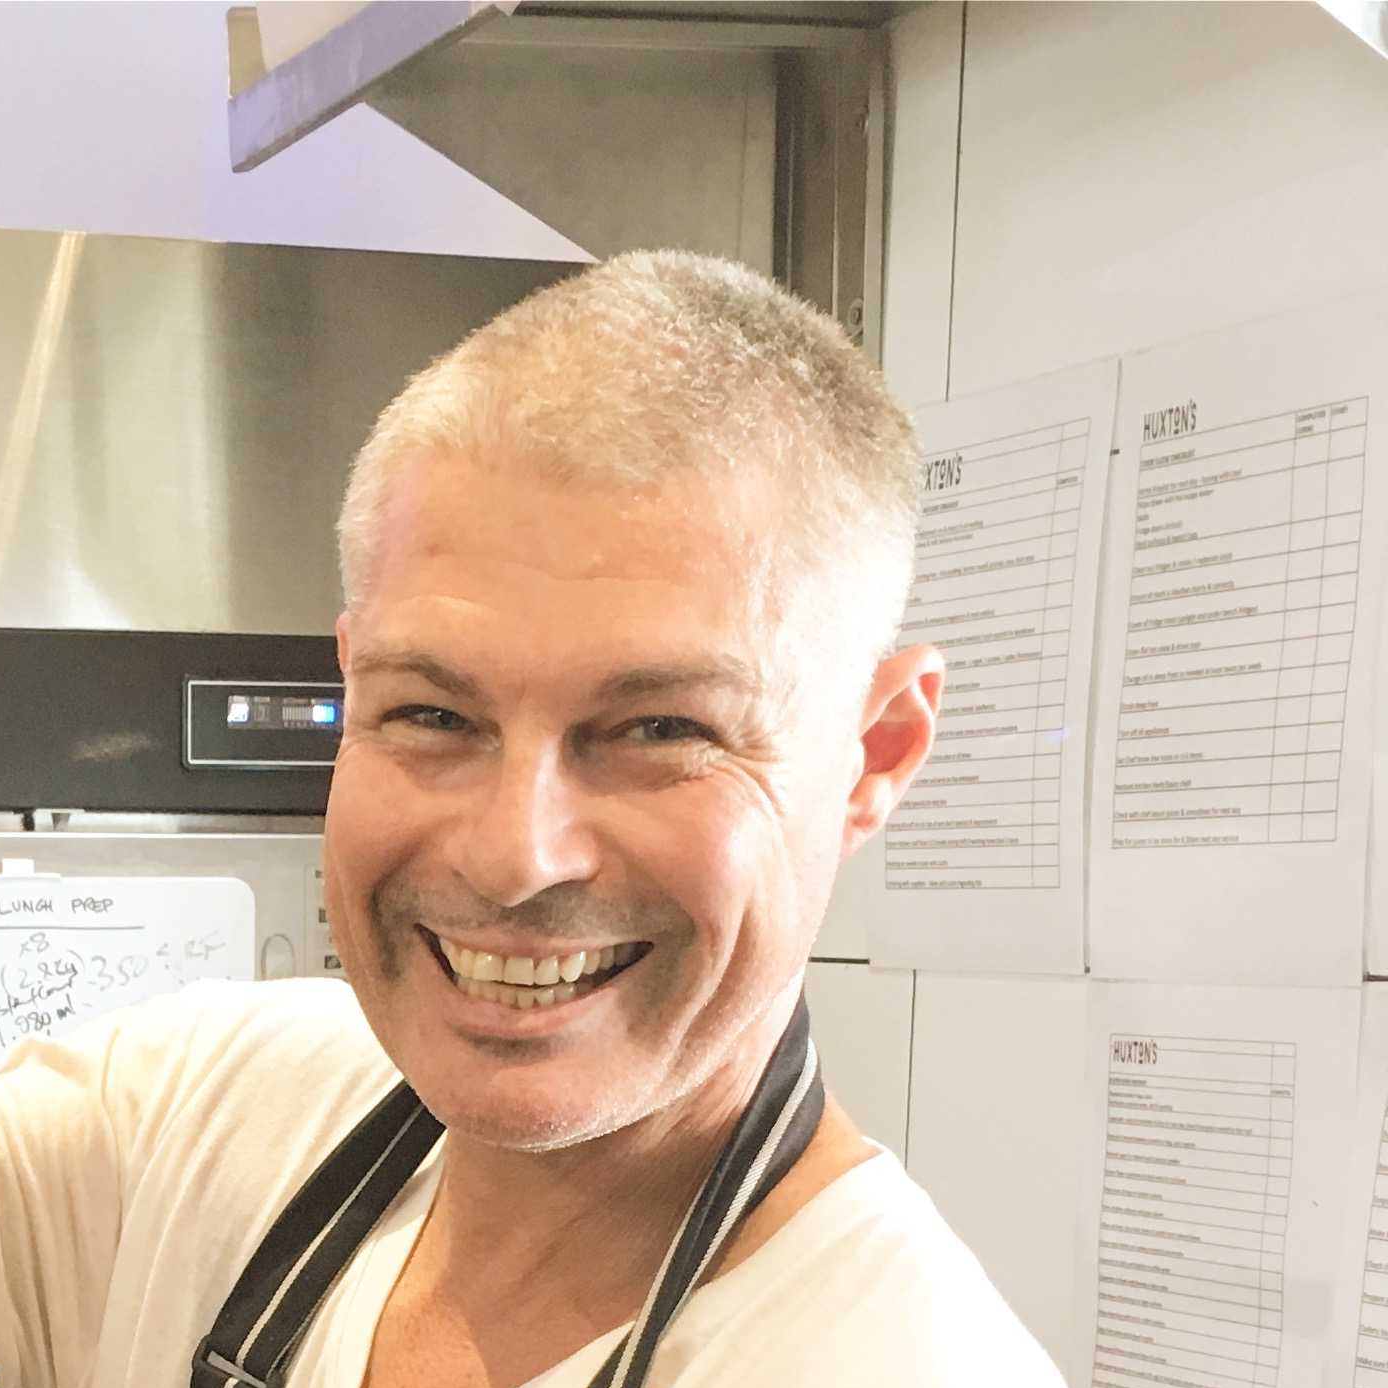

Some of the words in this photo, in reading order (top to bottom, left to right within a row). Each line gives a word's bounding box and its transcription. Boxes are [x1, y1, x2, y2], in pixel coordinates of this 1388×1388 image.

[1143, 399, 1197, 442] HUXTON'S
[924, 452, 963, 491] XTON'S
[71, 896, 114, 914] PREP
[1113, 1039, 1158, 1065] HUXTON'S
